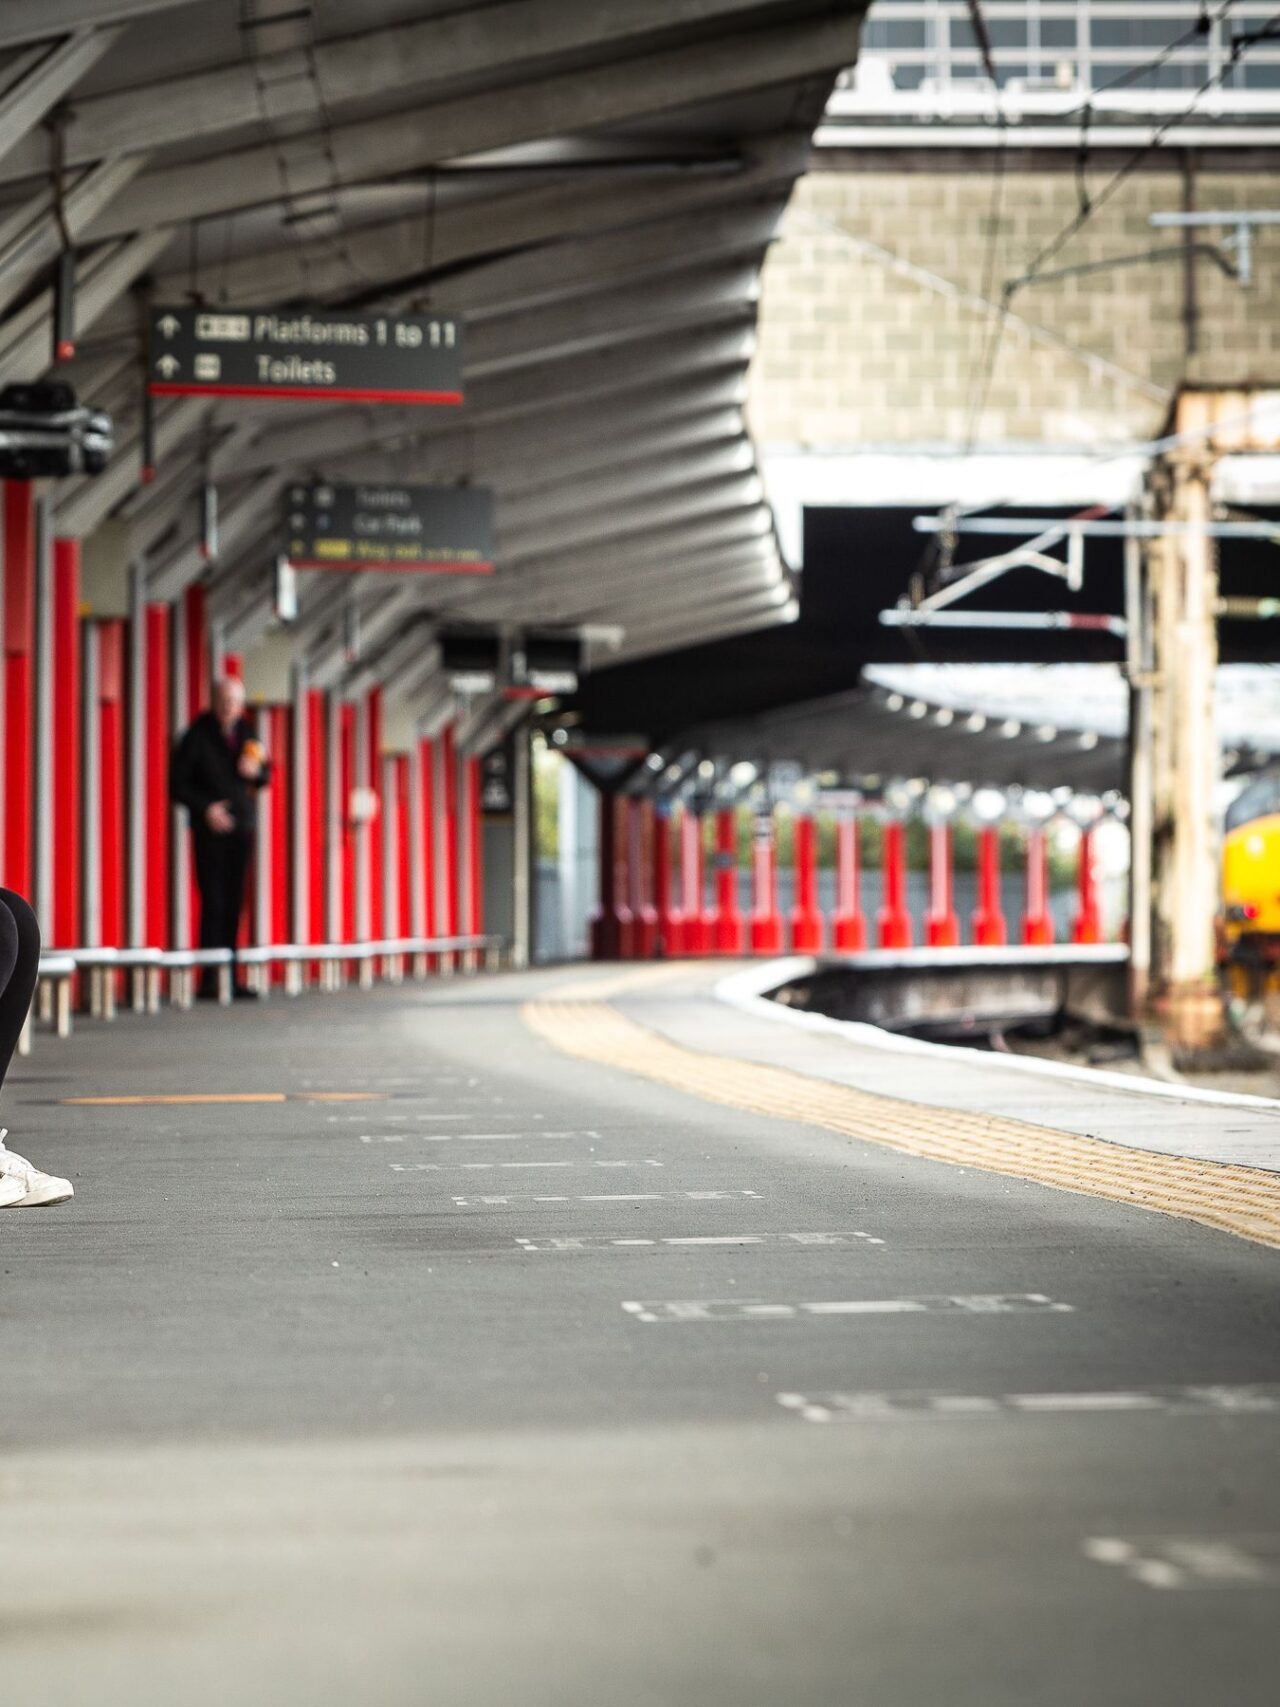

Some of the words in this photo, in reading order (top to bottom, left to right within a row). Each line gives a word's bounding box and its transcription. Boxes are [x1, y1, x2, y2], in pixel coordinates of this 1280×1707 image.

[254, 315, 370, 345] Platforms
[376, 318, 387, 346] 1
[395, 322, 423, 348] to
[429, 321, 456, 348] 11
[256, 354, 337, 384] Toilets
